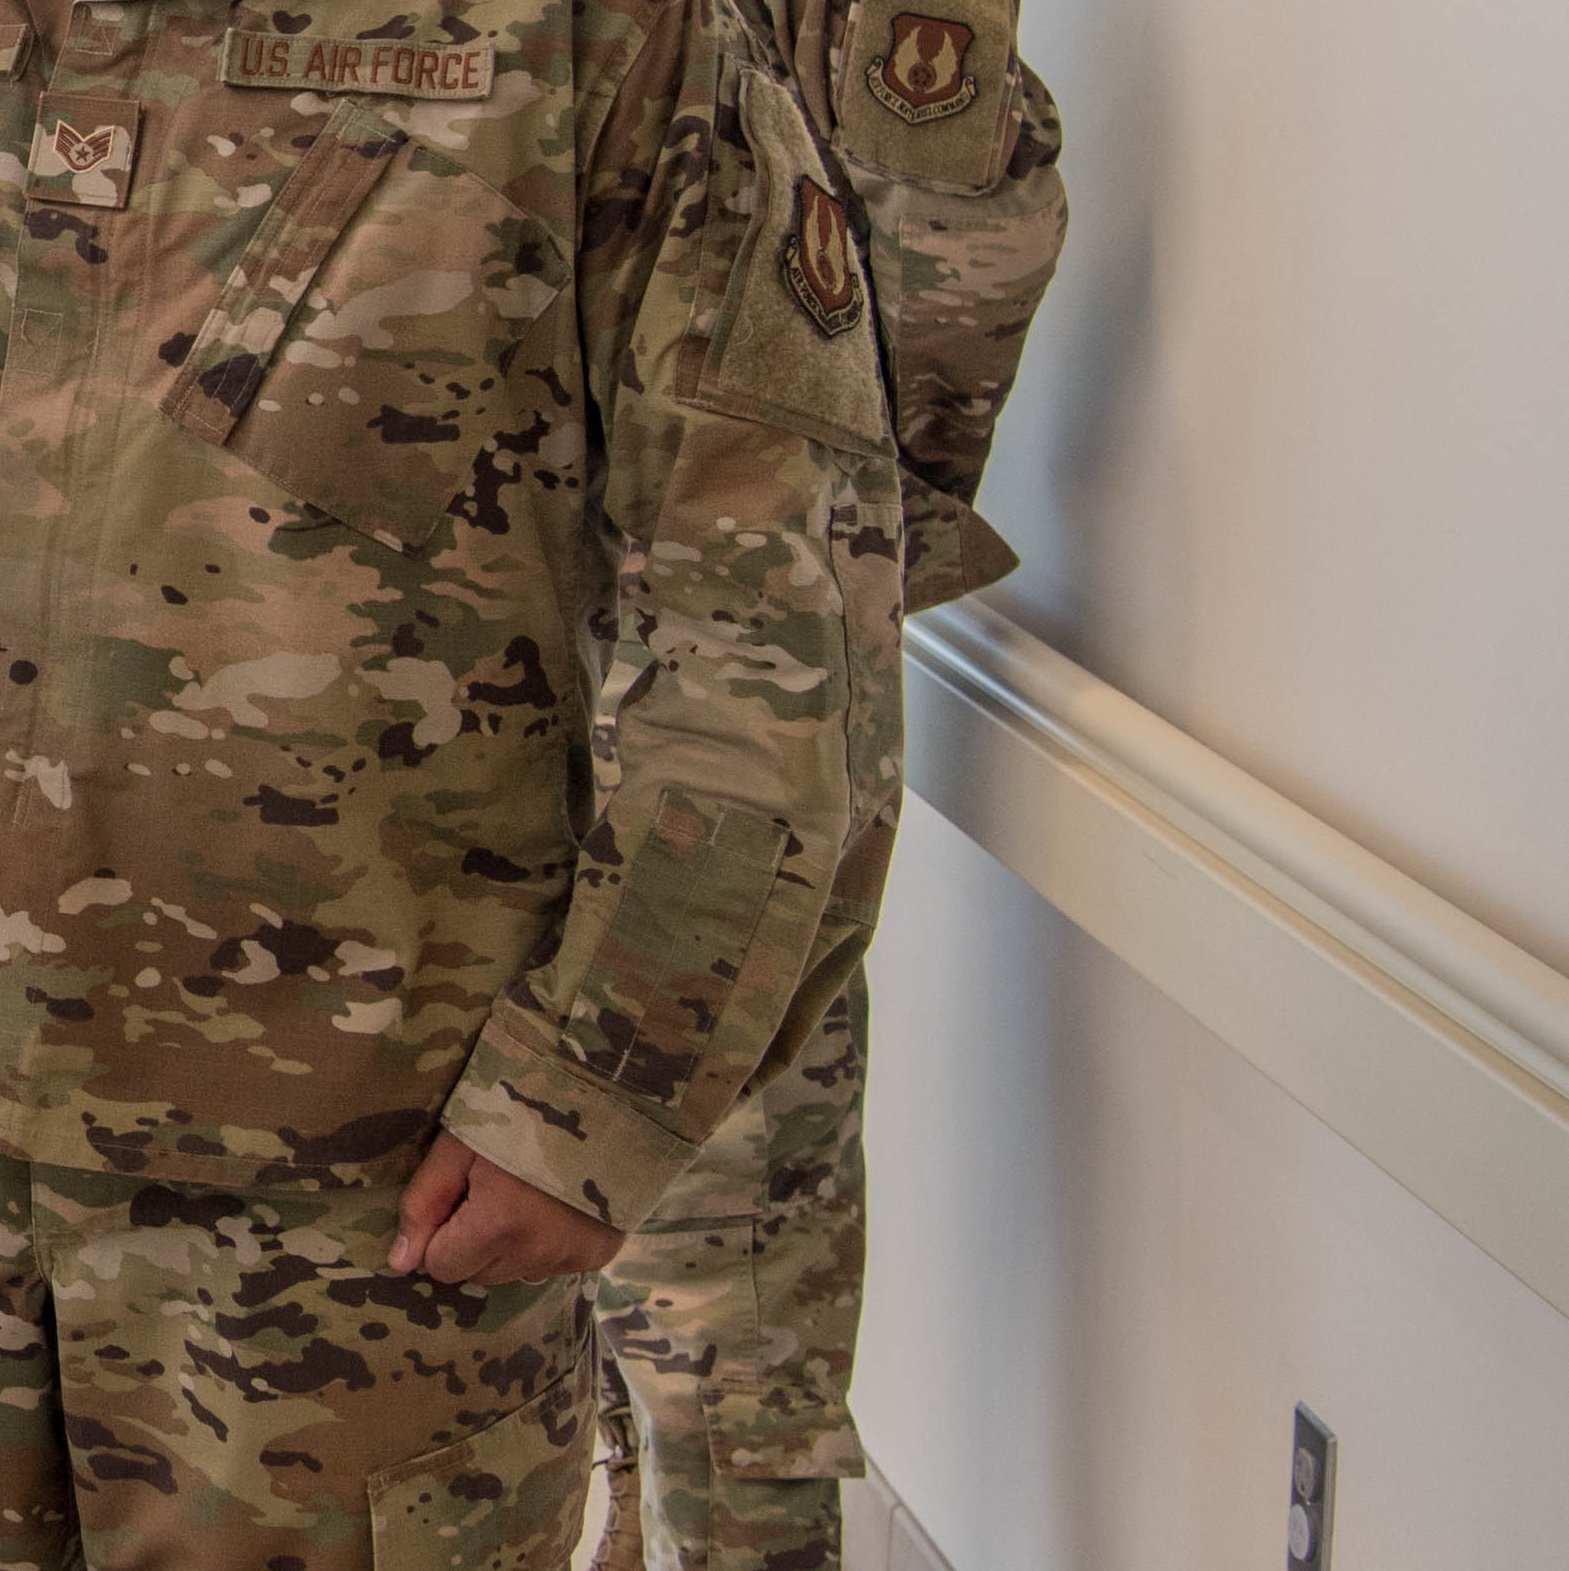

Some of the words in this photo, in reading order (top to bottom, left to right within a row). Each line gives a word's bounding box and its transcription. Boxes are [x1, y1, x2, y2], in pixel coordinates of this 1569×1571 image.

[240, 37, 291, 78] U.S.
[302, 42, 362, 84] AIR
[369, 45, 481, 90] FORCE
